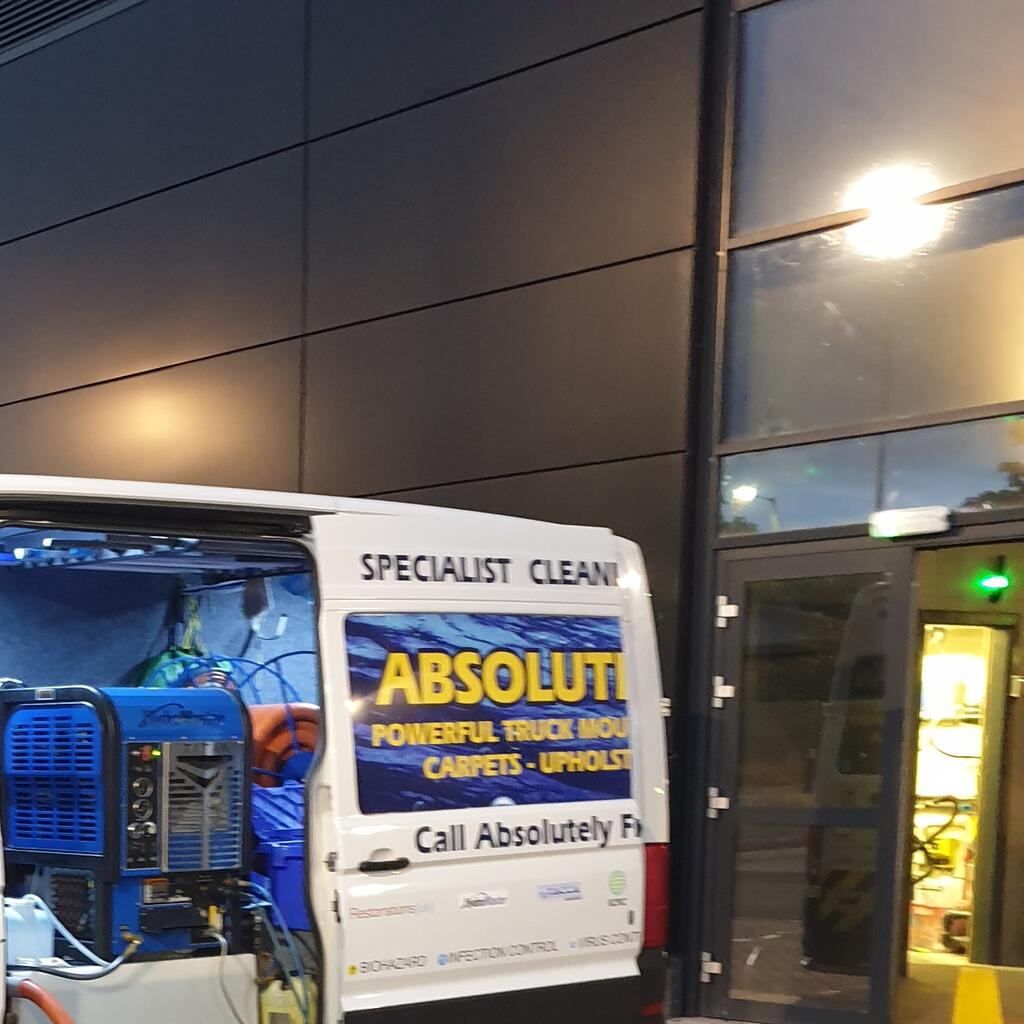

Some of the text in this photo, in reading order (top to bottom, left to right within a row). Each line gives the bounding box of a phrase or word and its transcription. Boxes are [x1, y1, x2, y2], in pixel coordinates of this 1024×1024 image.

[360, 553, 511, 584] SPECIALIST
[370, 721, 501, 747] POWERFUL
[501, 718, 574, 743] TRUCK
[422, 753, 523, 780] CARPETS
[538, 749, 634, 774] UPHOLST
[415, 825, 467, 854] Call
[474, 817, 614, 850] Absolutely
